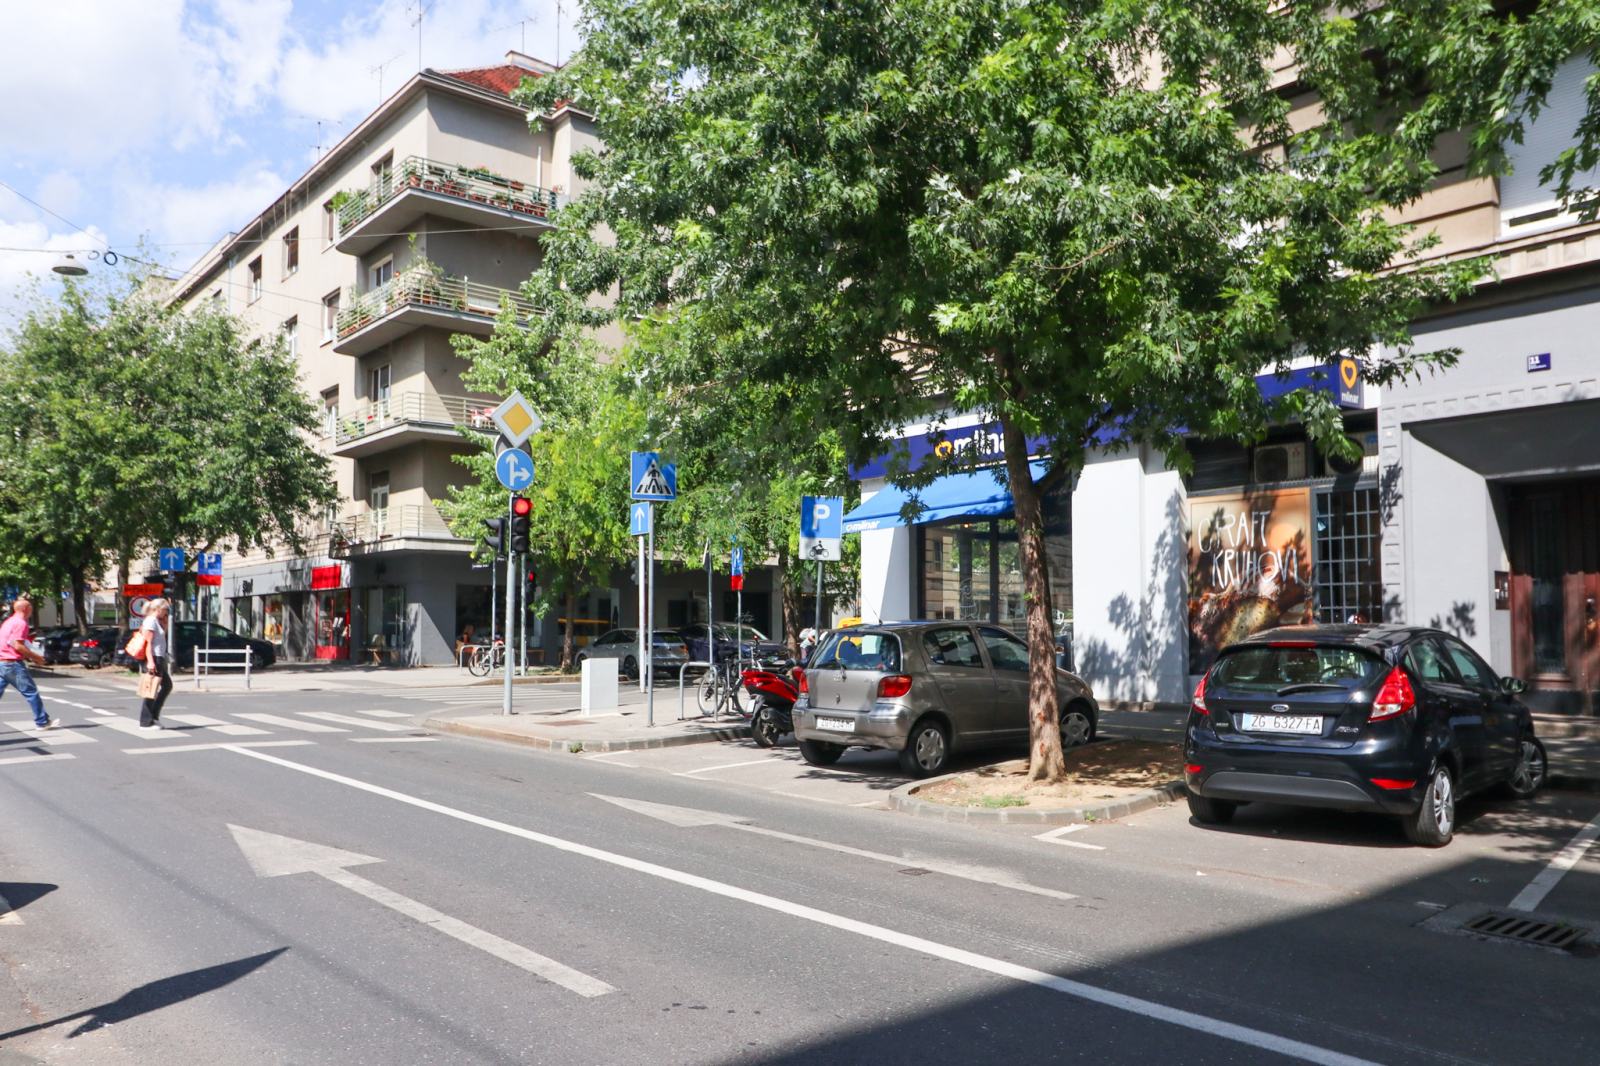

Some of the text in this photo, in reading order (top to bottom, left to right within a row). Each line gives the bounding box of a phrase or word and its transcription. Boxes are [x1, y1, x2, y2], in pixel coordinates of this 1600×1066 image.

[812, 503, 831, 530] P
[1198, 510, 1271, 553] CRAFT
[203, 552, 216, 569] P
[1212, 548, 1298, 589] KRUHOVI
[1251, 715, 1266, 728] ZG
